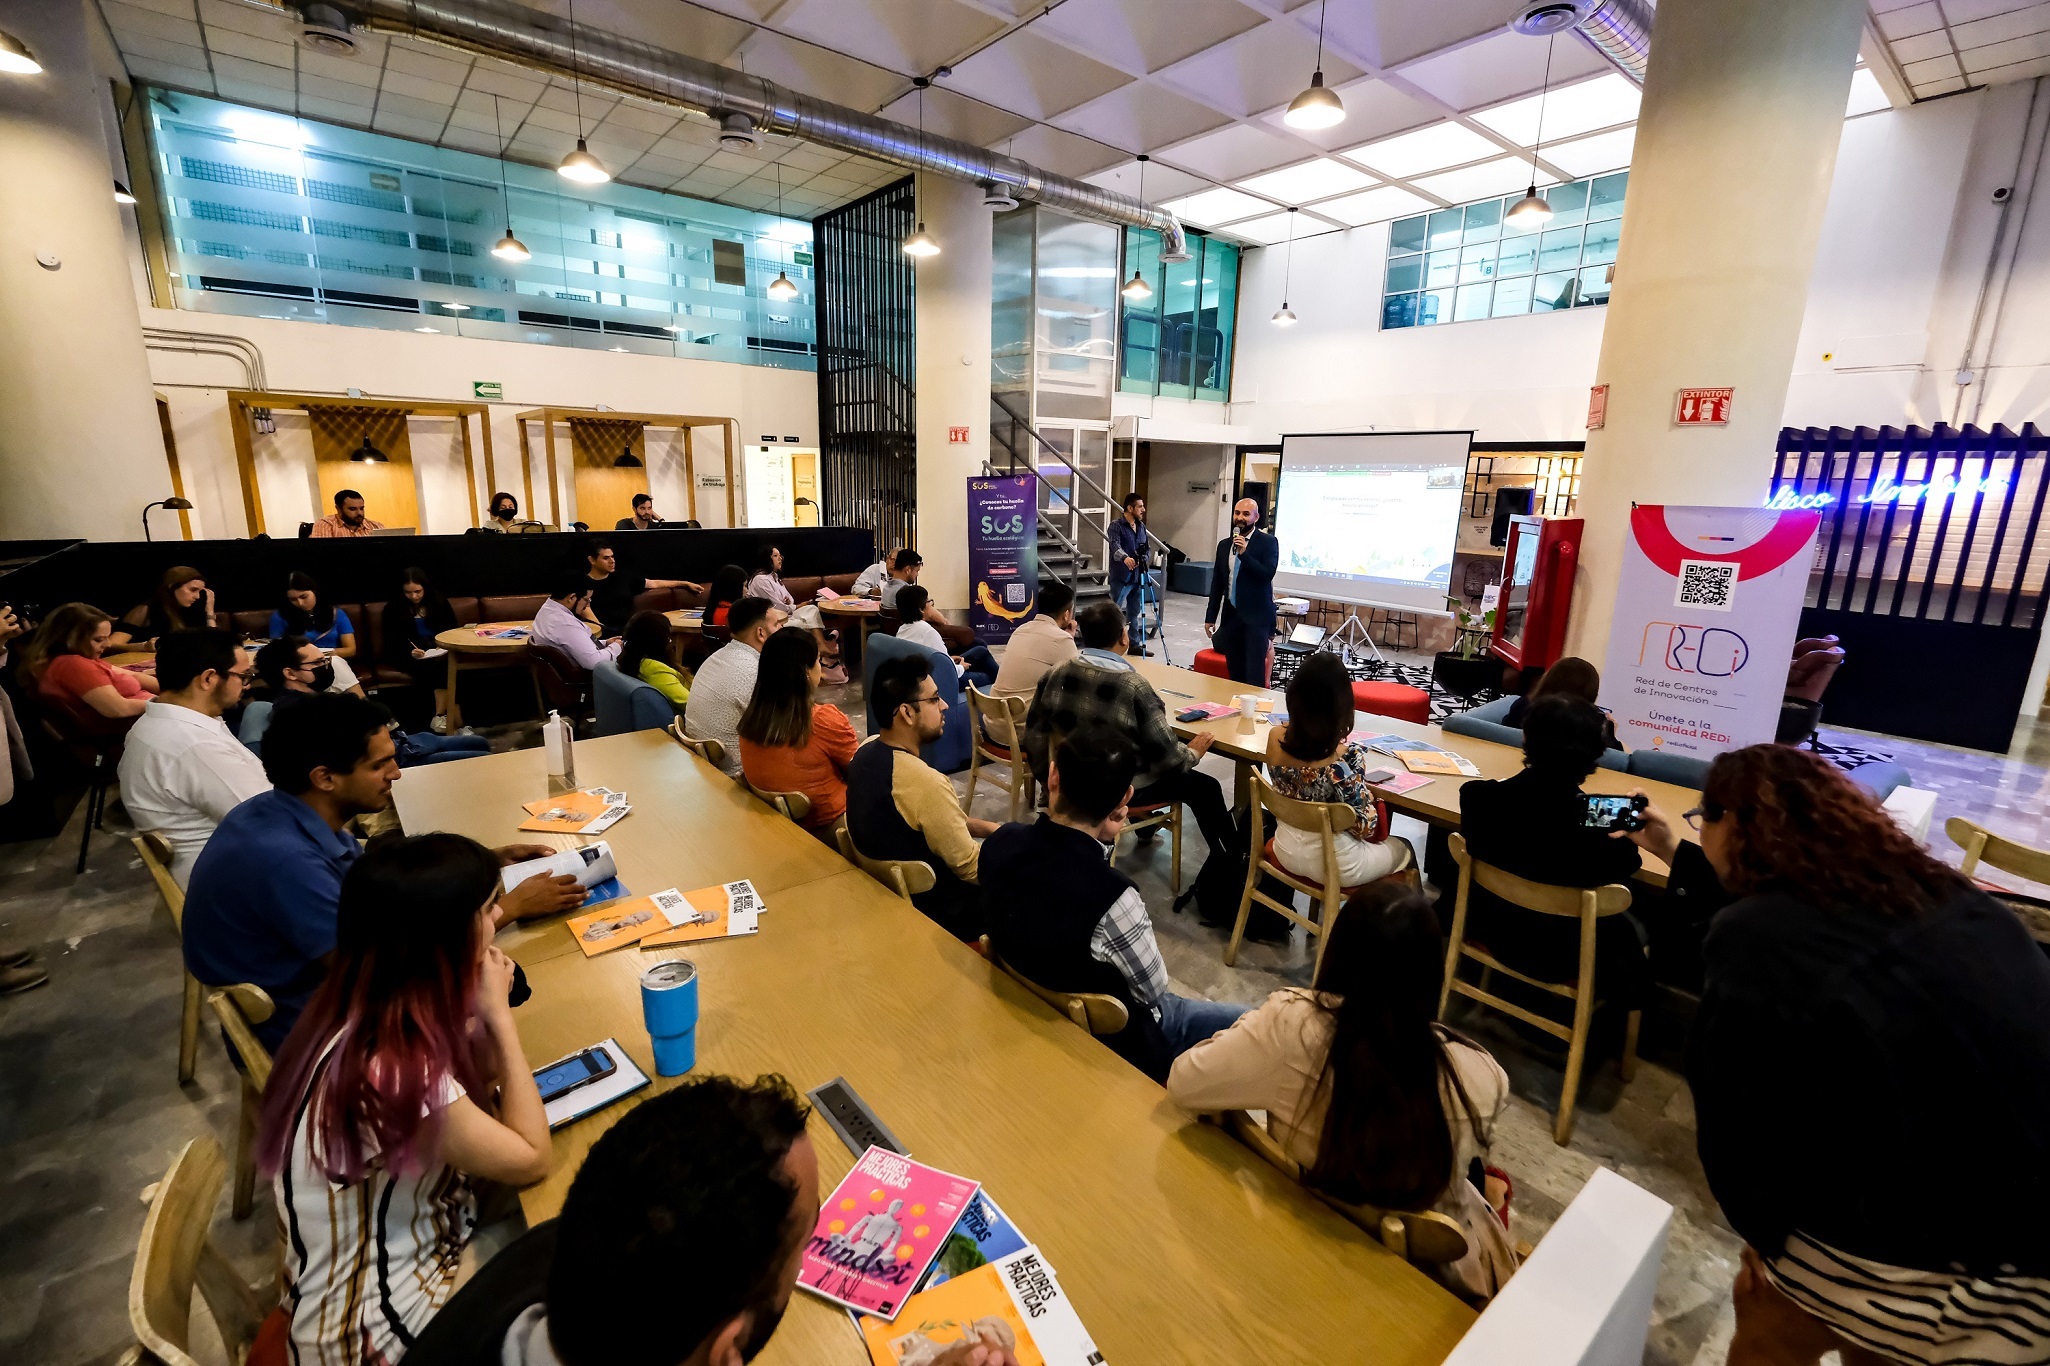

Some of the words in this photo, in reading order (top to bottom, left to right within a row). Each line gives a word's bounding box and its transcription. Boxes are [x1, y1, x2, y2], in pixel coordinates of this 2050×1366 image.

[1683, 390, 1730, 398] EXTINTOR
[981, 515, 1023, 534] SOS
[1635, 676, 1655, 686] Red
[1658, 680, 1671, 688] de
[1674, 682, 1718, 696] Centros
[1649, 689, 1709, 705] Innovación
[1628, 719, 1697, 738] comunidad
[1700, 731, 1731, 744] REDi
[1649, 710, 1685, 725] Únete
[1700, 720, 1711, 730] la
[868, 1150, 911, 1175] MEJORES
[858, 1161, 912, 1190] PRACTICAS
[961, 1211, 992, 1242] CTICAS
[804, 1235, 914, 1285] mindset
[1005, 1260, 1047, 1318] PRACTICAS
[1020, 1254, 1056, 1302] MEJORES
